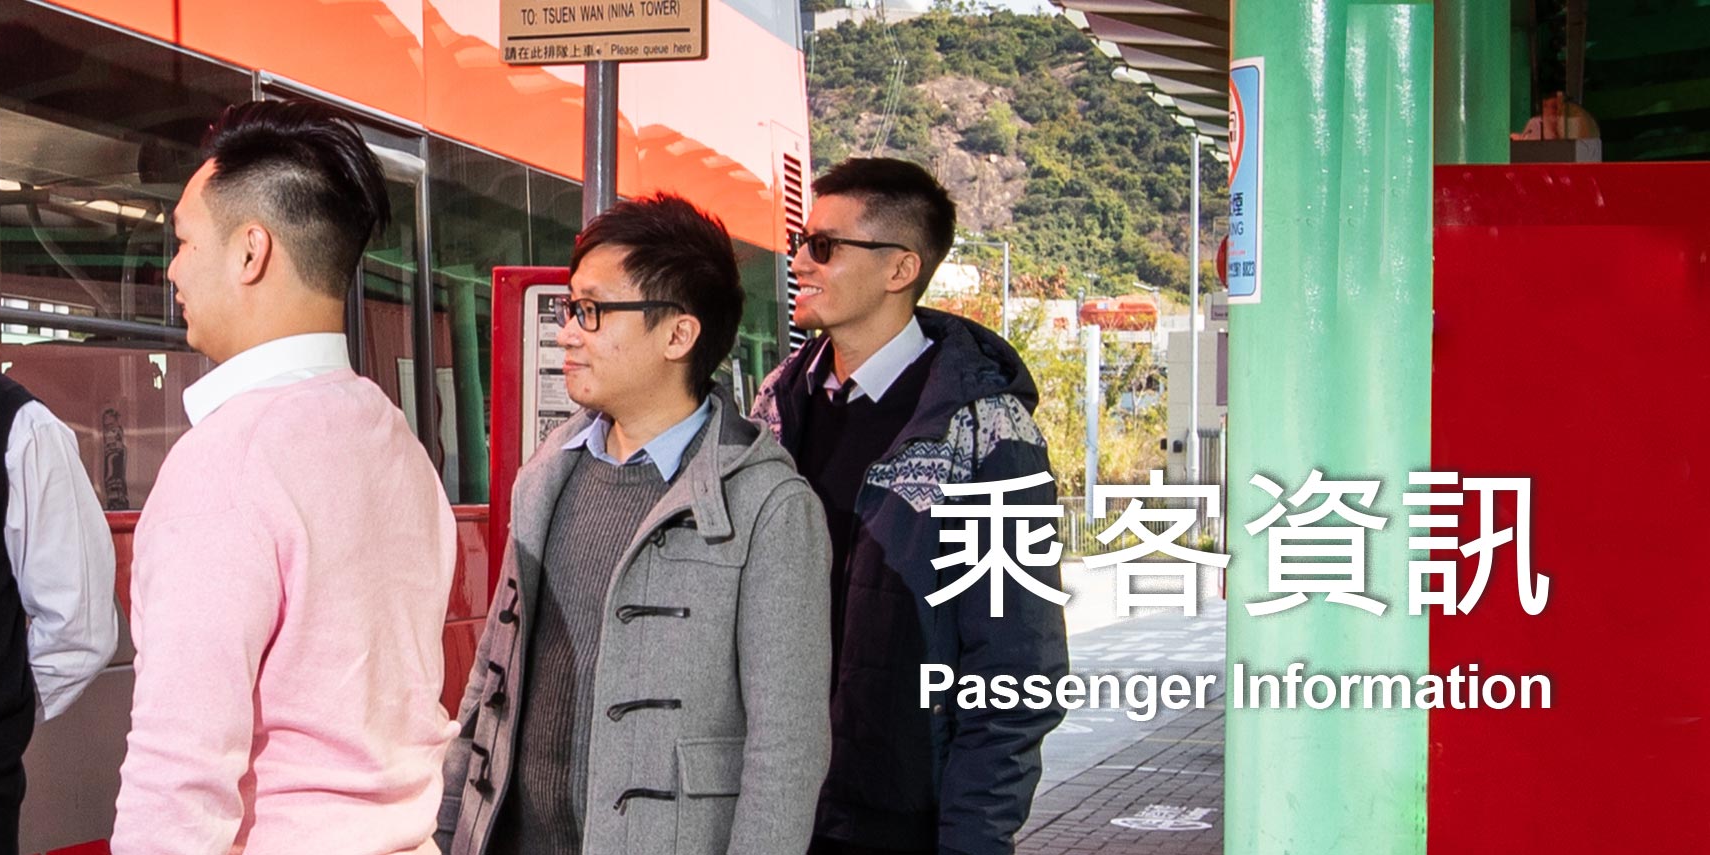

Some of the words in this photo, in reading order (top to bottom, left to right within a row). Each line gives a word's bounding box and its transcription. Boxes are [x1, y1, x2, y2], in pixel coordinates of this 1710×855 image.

[521, 9, 538, 25] TO:
[543, 6, 576, 24] TSUEN
[580, 4, 604, 21] WAN
[607, 2, 635, 21] (NINA
[640, 0, 681, 18] TOWER)
[610, 43, 639, 56] Please
[643, 44, 669, 55] queue
[673, 42, 692, 54] here
